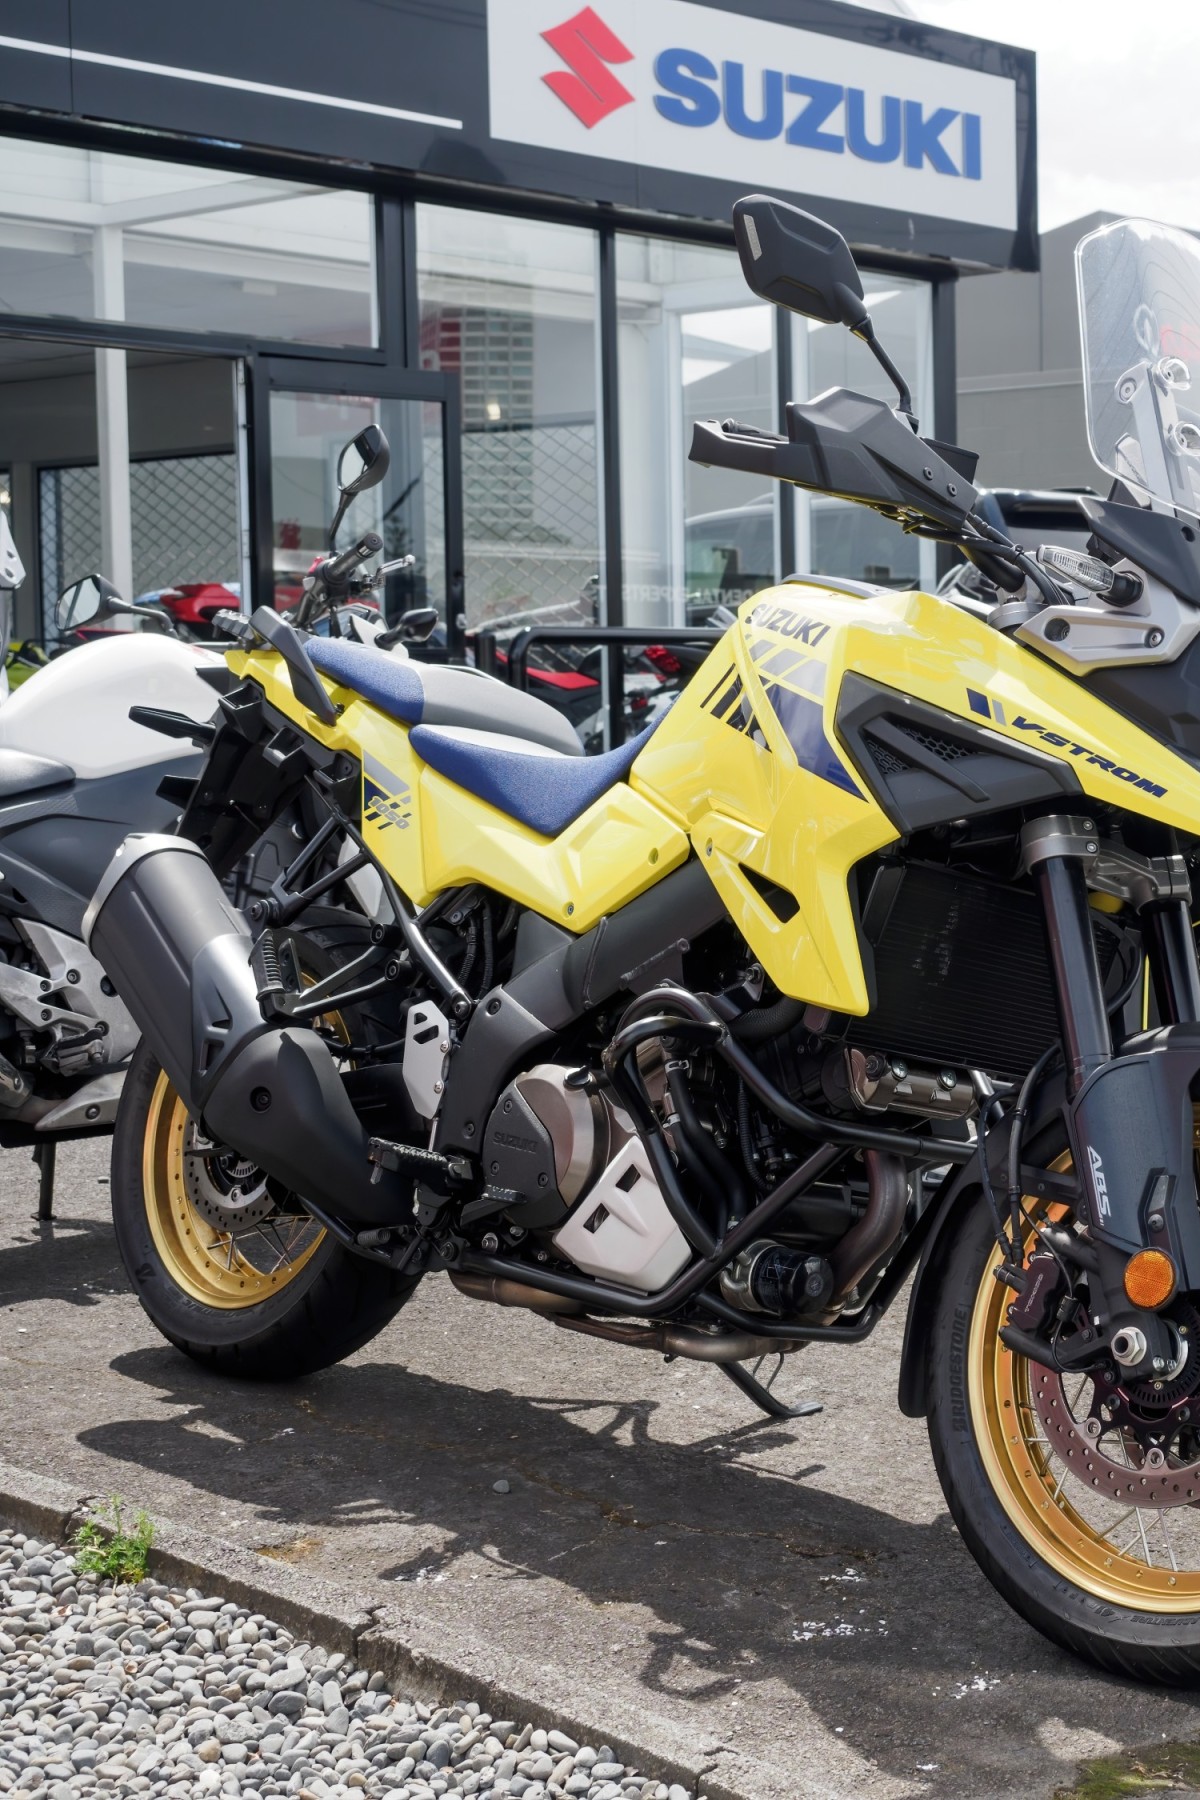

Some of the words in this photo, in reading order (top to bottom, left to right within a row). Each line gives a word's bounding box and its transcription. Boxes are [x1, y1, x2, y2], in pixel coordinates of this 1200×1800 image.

[653, 47, 982, 181] SUZUKI
[744, 603, 831, 647] SUZUKI
[1011, 715, 1169, 798] V-STROM
[367, 795, 410, 830] 1050
[492, 1131, 538, 1154] SUZUKI
[1088, 1145, 1112, 1219] ABS
[951, 1307, 969, 1433] BRIDGESTONE
